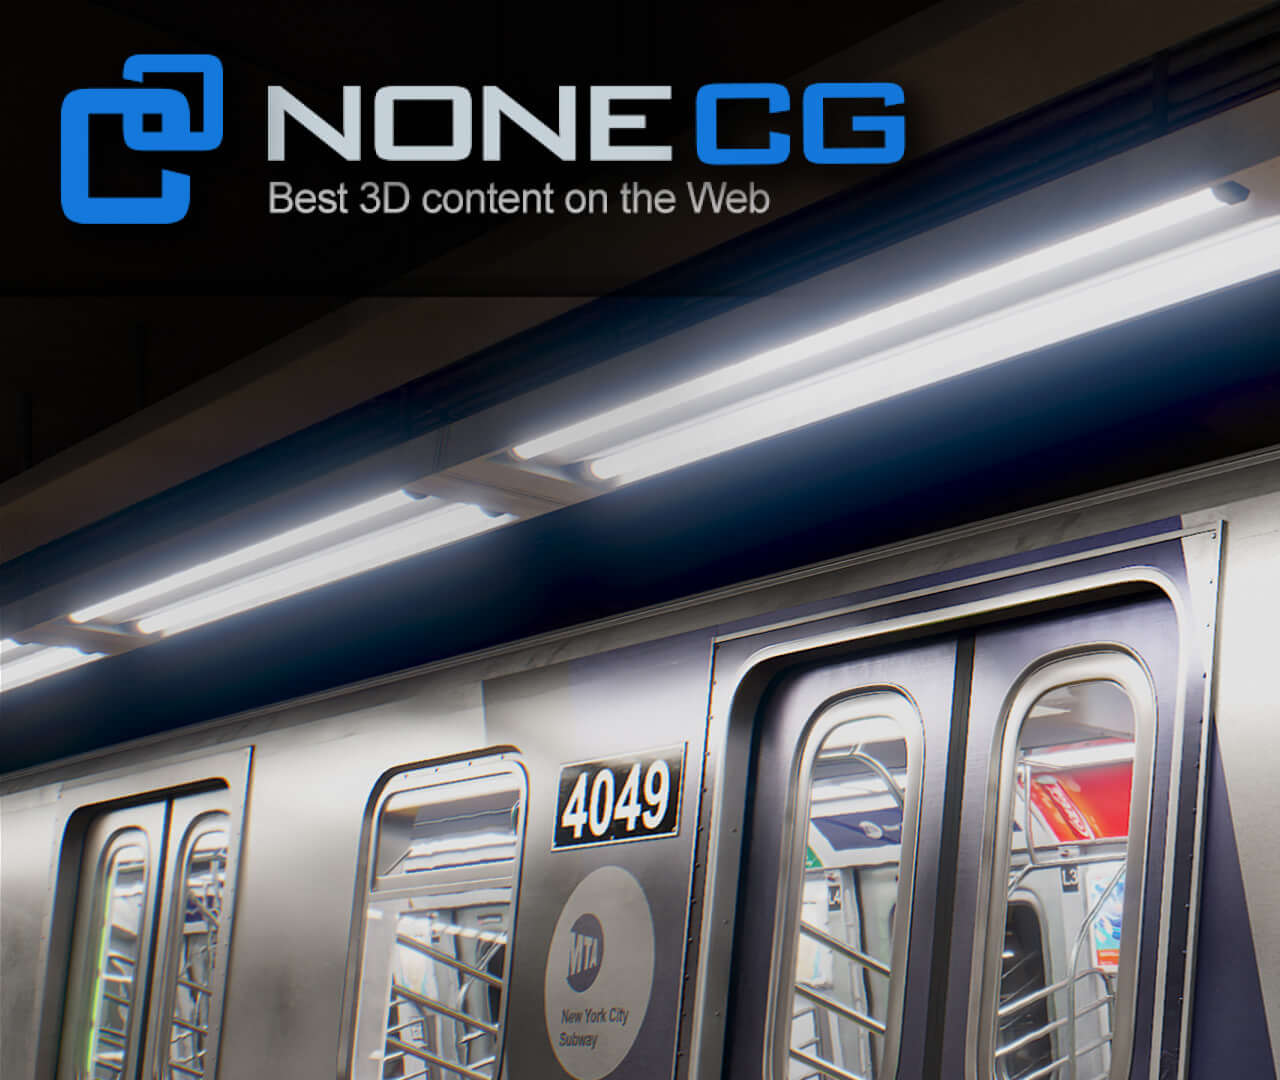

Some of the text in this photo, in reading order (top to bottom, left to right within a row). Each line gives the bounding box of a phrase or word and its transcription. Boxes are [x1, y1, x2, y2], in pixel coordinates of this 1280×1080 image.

[561, 759, 670, 839] 4049
[569, 932, 600, 976] MTA
[561, 1007, 630, 1027] New York City
[559, 1032, 599, 1050] Subway
